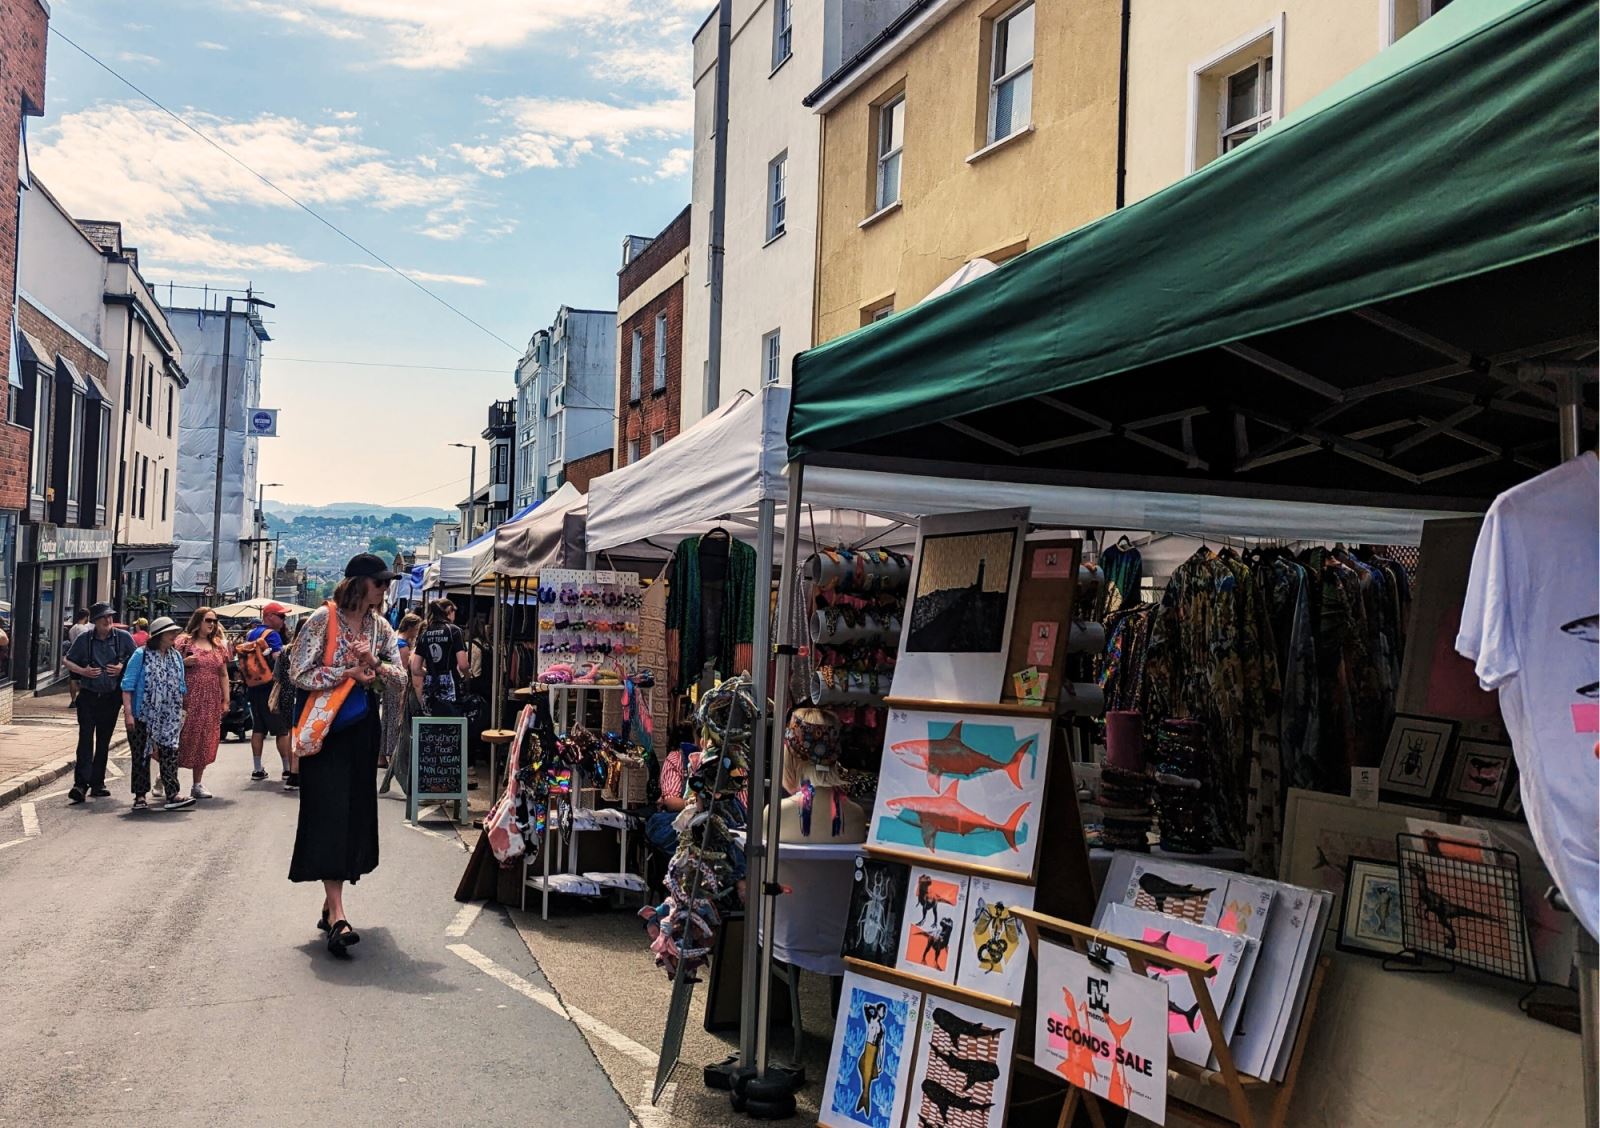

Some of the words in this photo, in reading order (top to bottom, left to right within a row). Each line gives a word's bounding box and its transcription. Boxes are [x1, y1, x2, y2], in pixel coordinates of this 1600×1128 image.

[426, 629, 444, 637] EXETER
[420, 731, 460, 747] Everything
[423, 745, 431, 753] is
[439, 755, 460, 765] VEGAN
[423, 765, 436, 775] NON
[437, 766, 461, 775] GLUTEN
[1046, 1018, 1110, 1058] SECONDS
[1115, 1047, 1153, 1078] SALE
